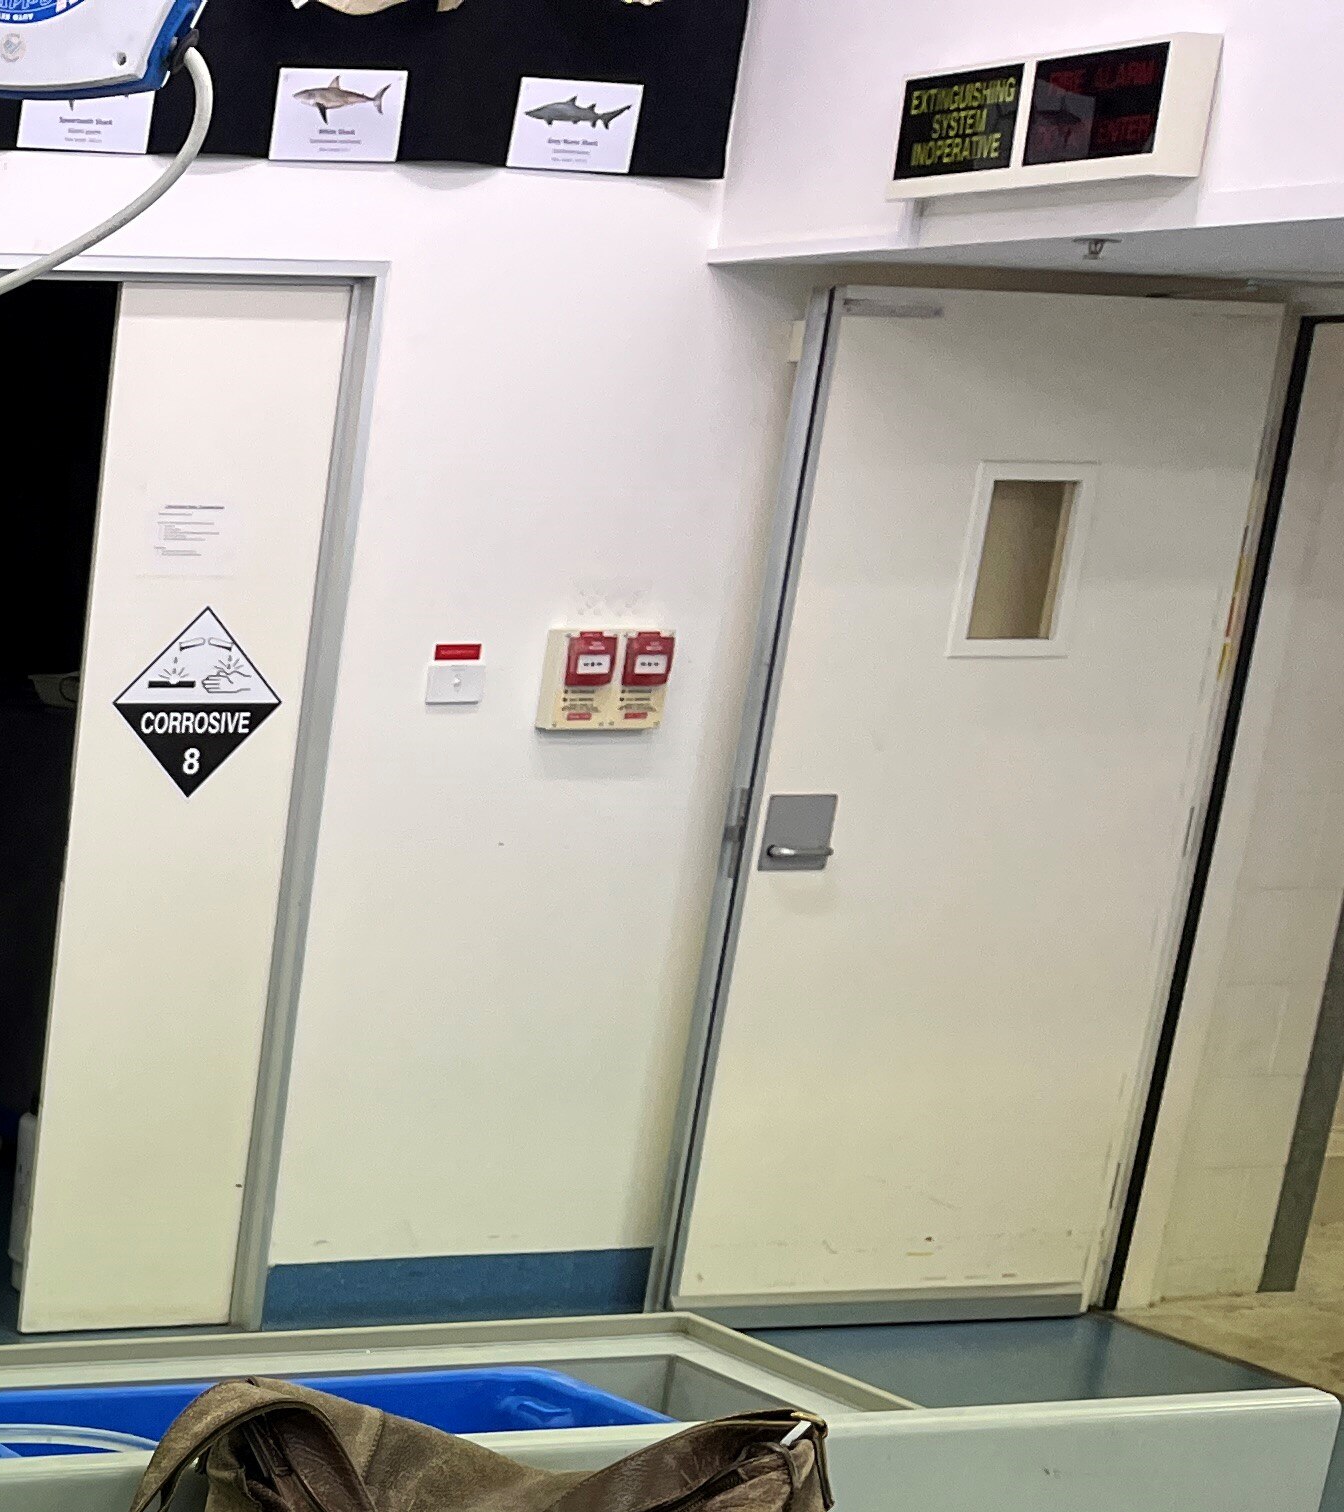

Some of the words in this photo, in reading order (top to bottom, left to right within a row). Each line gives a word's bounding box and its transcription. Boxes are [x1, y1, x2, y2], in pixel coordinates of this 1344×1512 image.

[910, 76, 1017, 115] EXTINGUISHING
[931, 108, 987, 139] SYSTEM
[911, 132, 1002, 166] INOPERATIVE
[140, 711, 252, 734] CORROSIVE
[182, 747, 201, 775] 8
